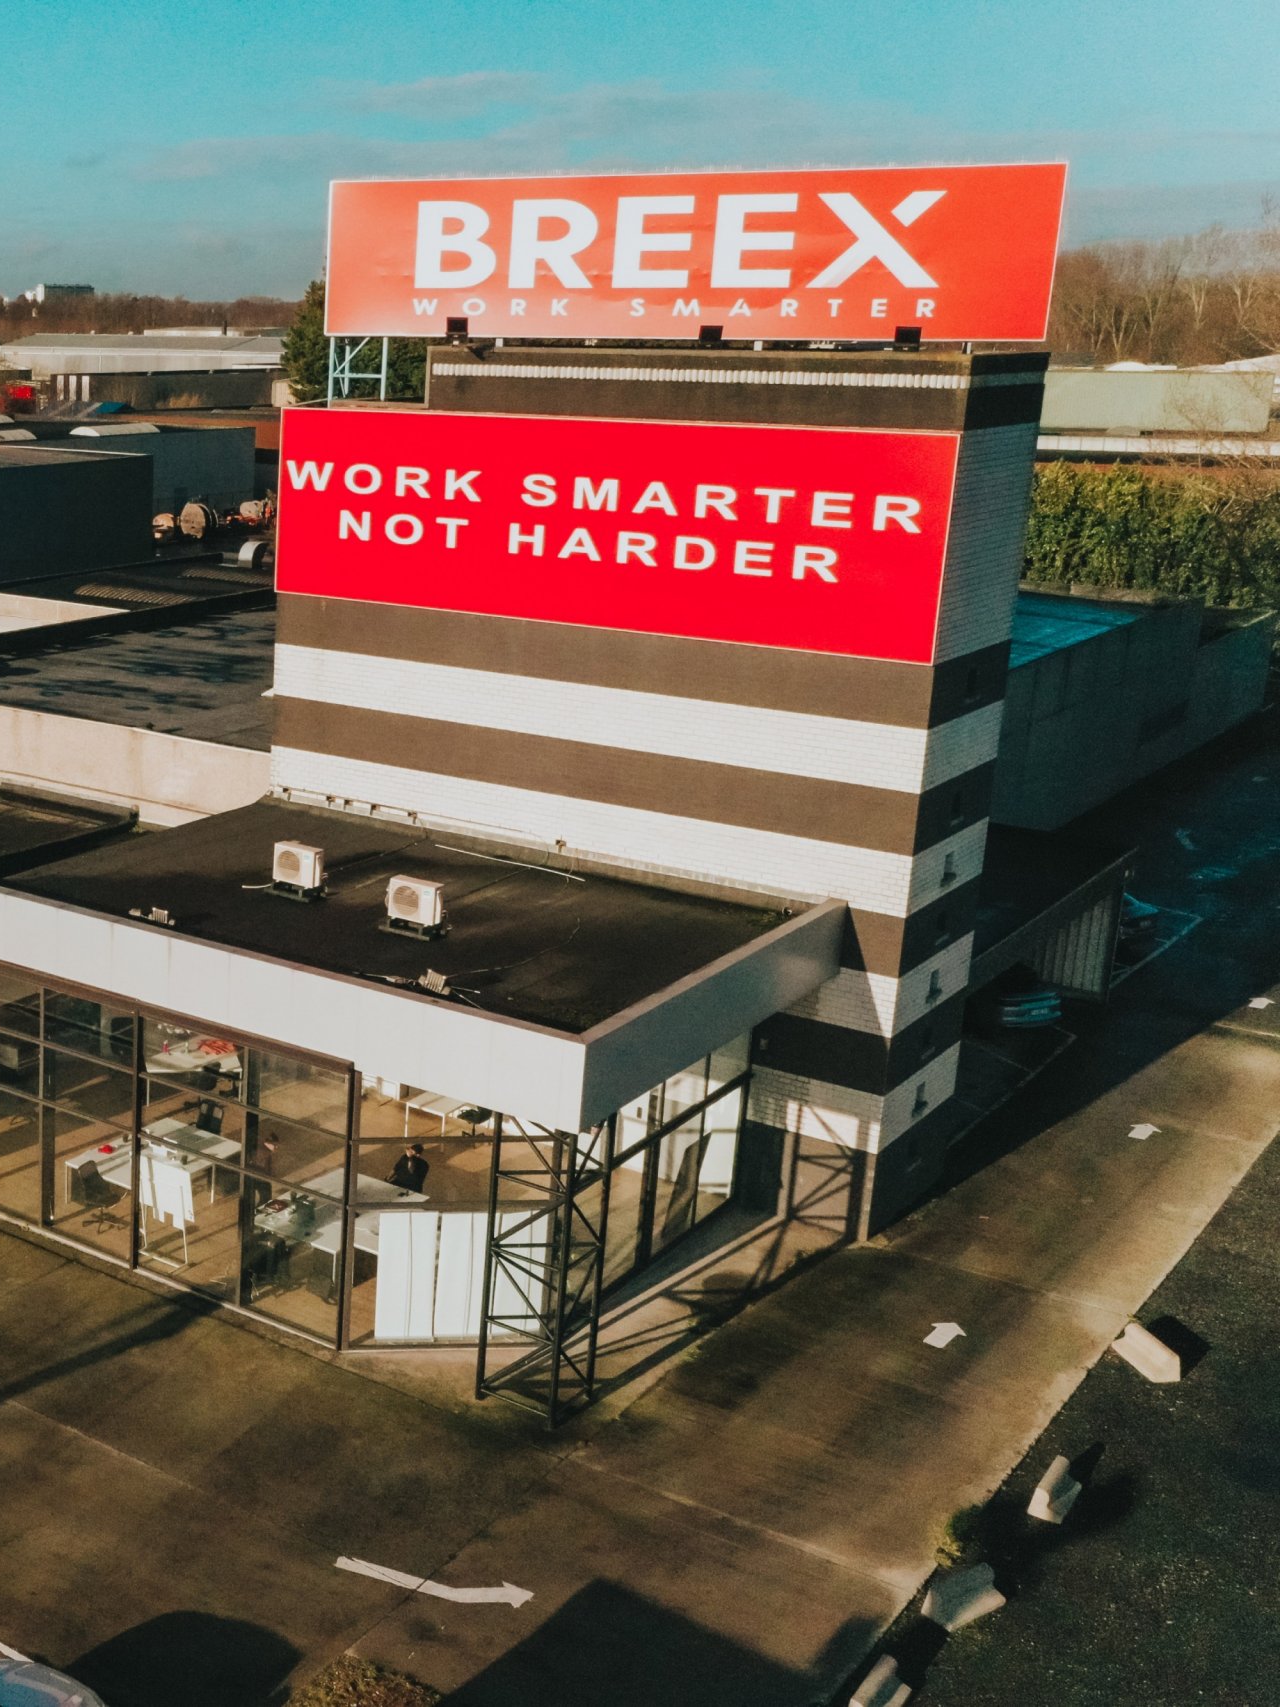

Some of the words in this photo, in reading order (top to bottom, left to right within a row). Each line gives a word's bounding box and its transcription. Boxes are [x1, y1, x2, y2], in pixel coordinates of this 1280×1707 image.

[412, 189, 948, 289] BREEX
[411, 297, 569, 319] WORK
[628, 297, 936, 319] SMARTER
[285, 458, 483, 504] WORK
[520, 472, 922, 535] SMARTER
[337, 508, 470, 550] NOT
[507, 521, 839, 584] HARDER
